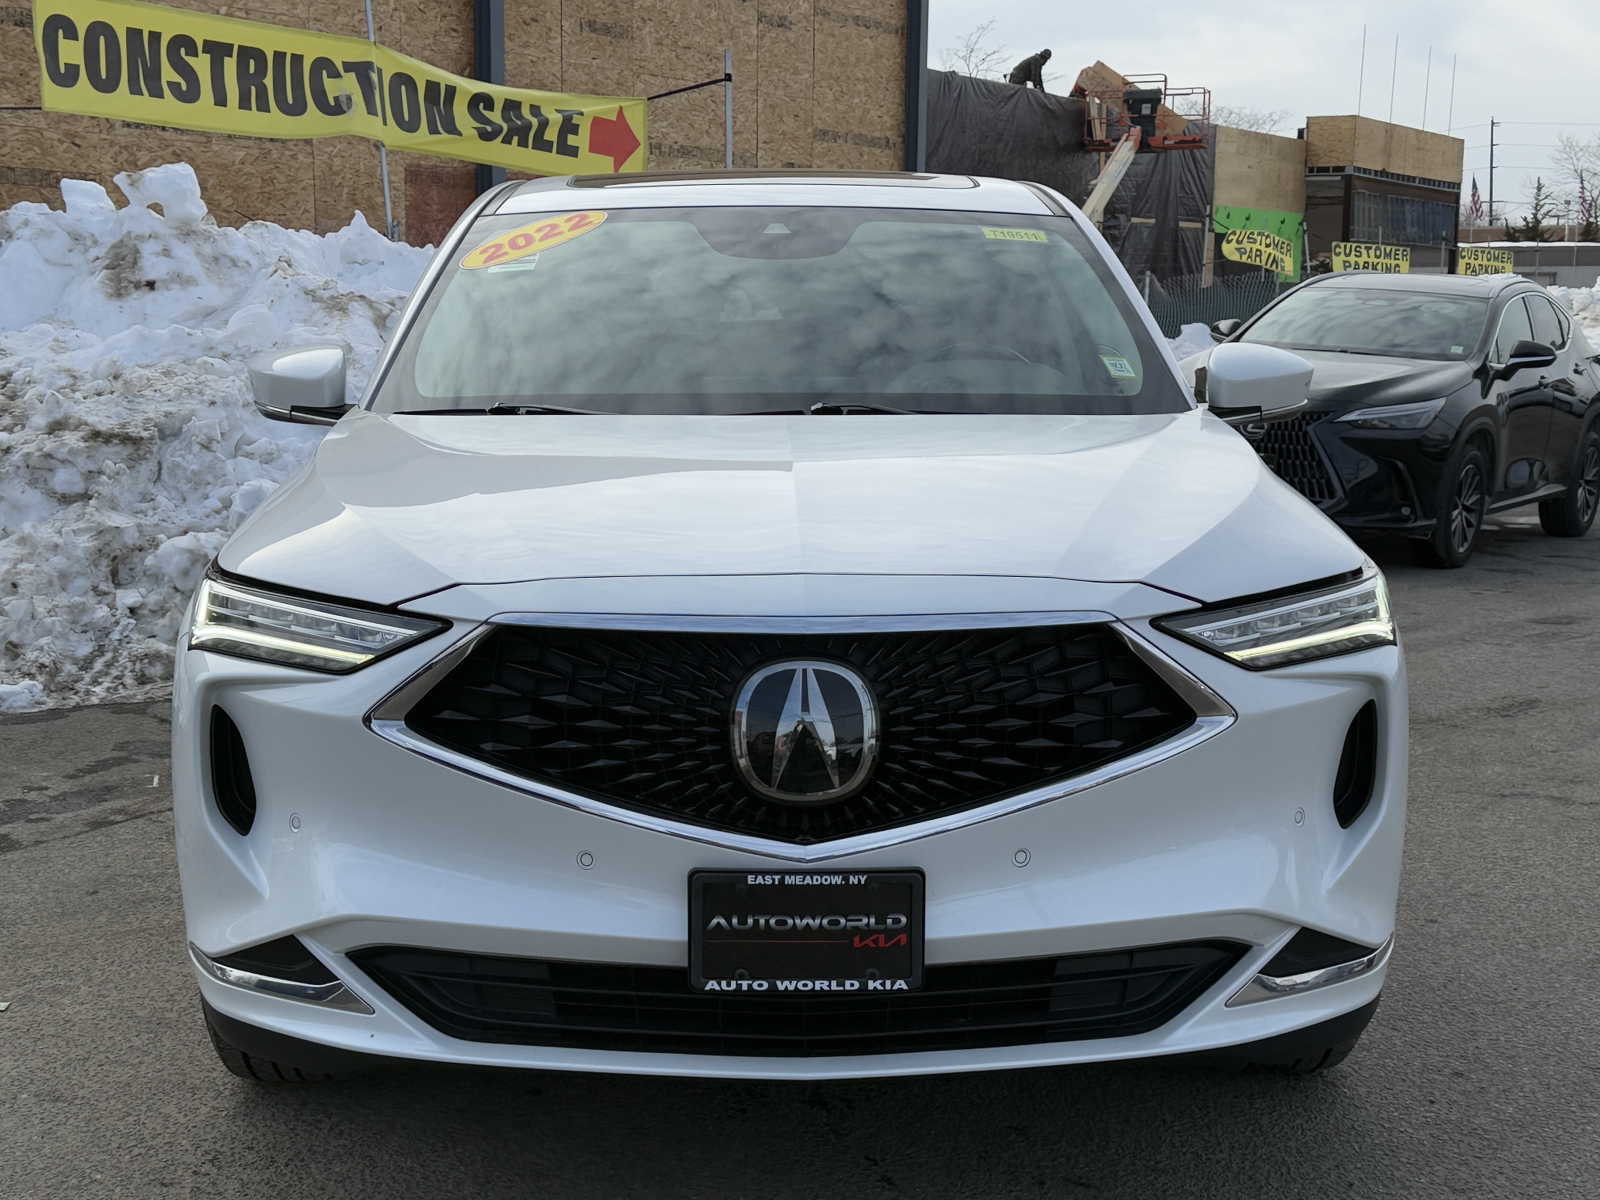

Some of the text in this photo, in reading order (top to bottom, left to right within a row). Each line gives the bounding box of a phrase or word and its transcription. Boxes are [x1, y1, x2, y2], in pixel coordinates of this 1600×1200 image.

[42, 13, 585, 158] CONSTRUCTION SALE
[478, 212, 595, 265] 2022
[1225, 229, 1293, 258] CUSTOMER
[1234, 246, 1286, 272] PARING
[1333, 243, 1408, 262] CUSTOMER
[1459, 247, 1513, 264] CUSTOMER
[1342, 259, 1401, 273] PARKING
[747, 874, 781, 885] EAST
[849, 874, 868, 885] NY
[706, 912, 908, 931] AUTOWORLD
[852, 933, 908, 948] KIA
[704, 979, 909, 991] AUTO WORLD KIA
